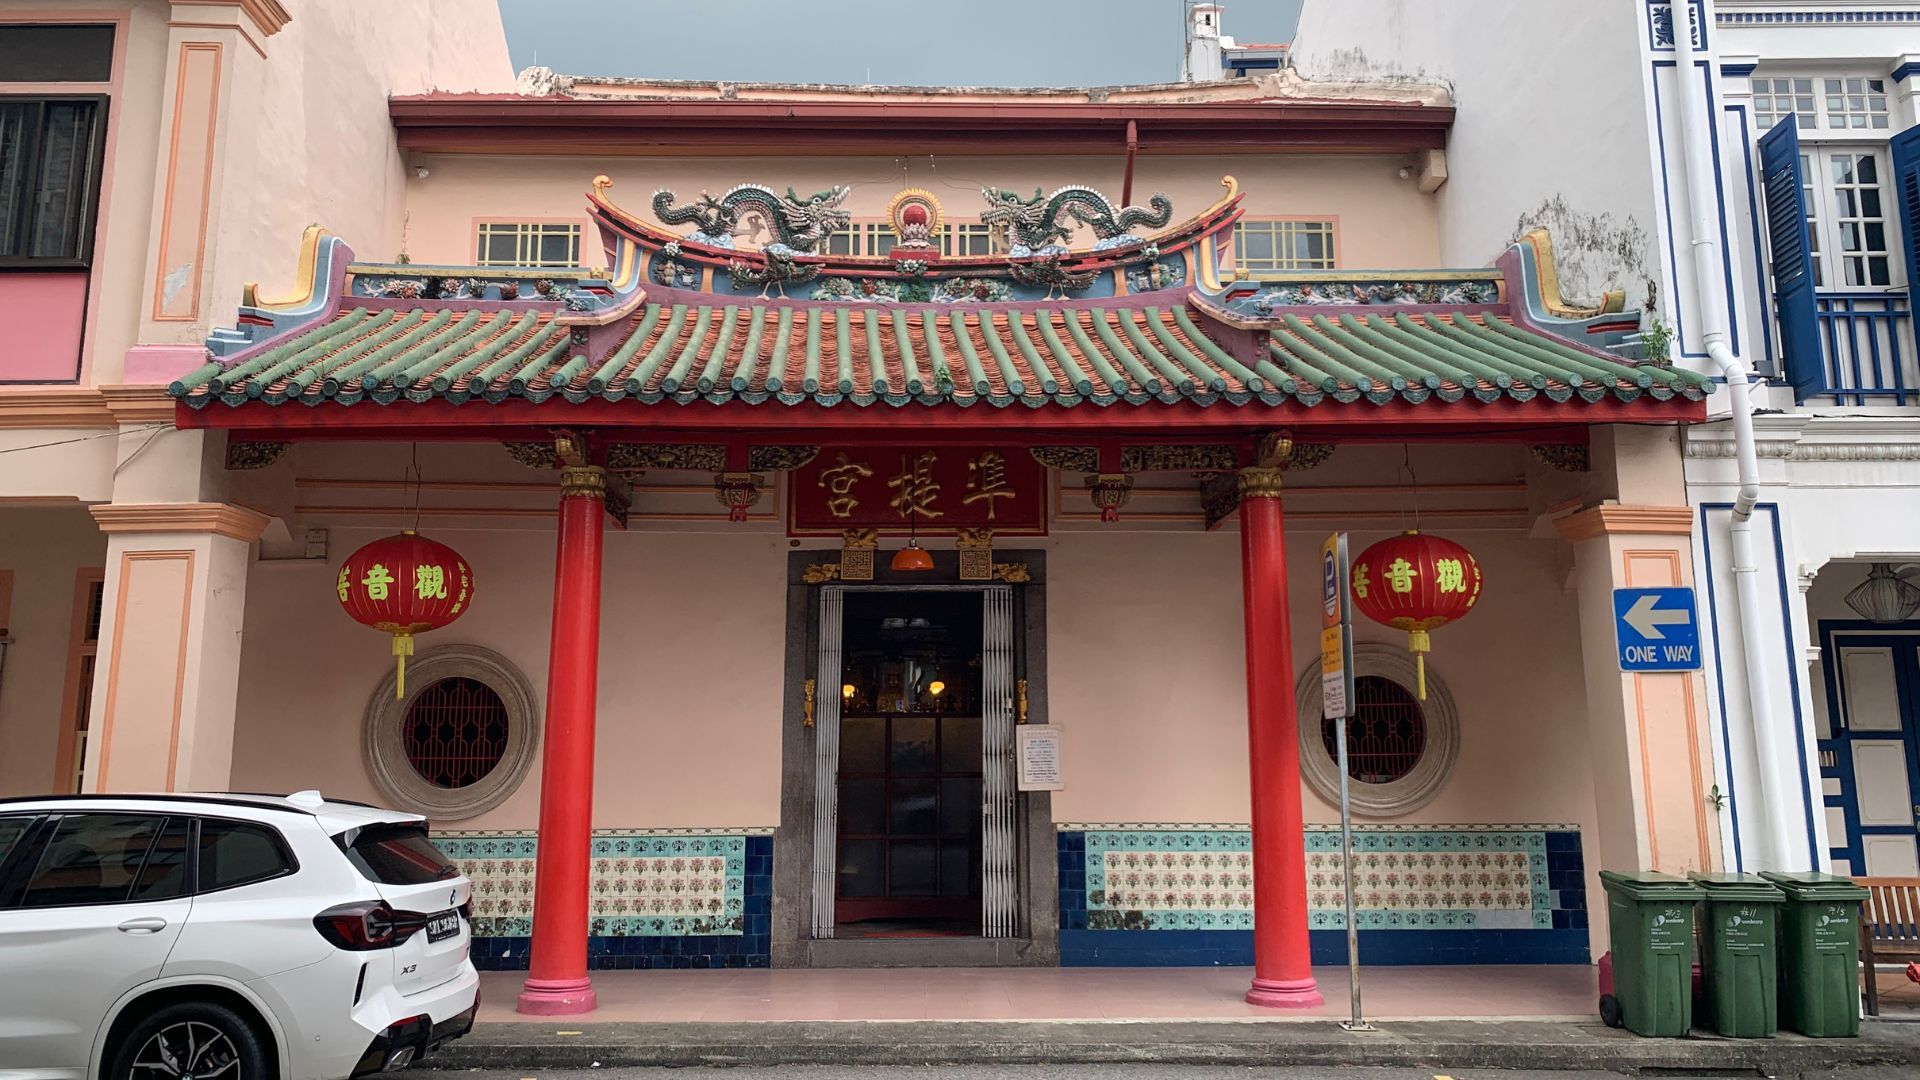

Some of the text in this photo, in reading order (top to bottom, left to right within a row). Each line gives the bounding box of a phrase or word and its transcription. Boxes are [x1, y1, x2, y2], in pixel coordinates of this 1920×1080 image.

[1625, 645, 1693, 663] ONE WAY
[400, 964, 417, 976] X3
